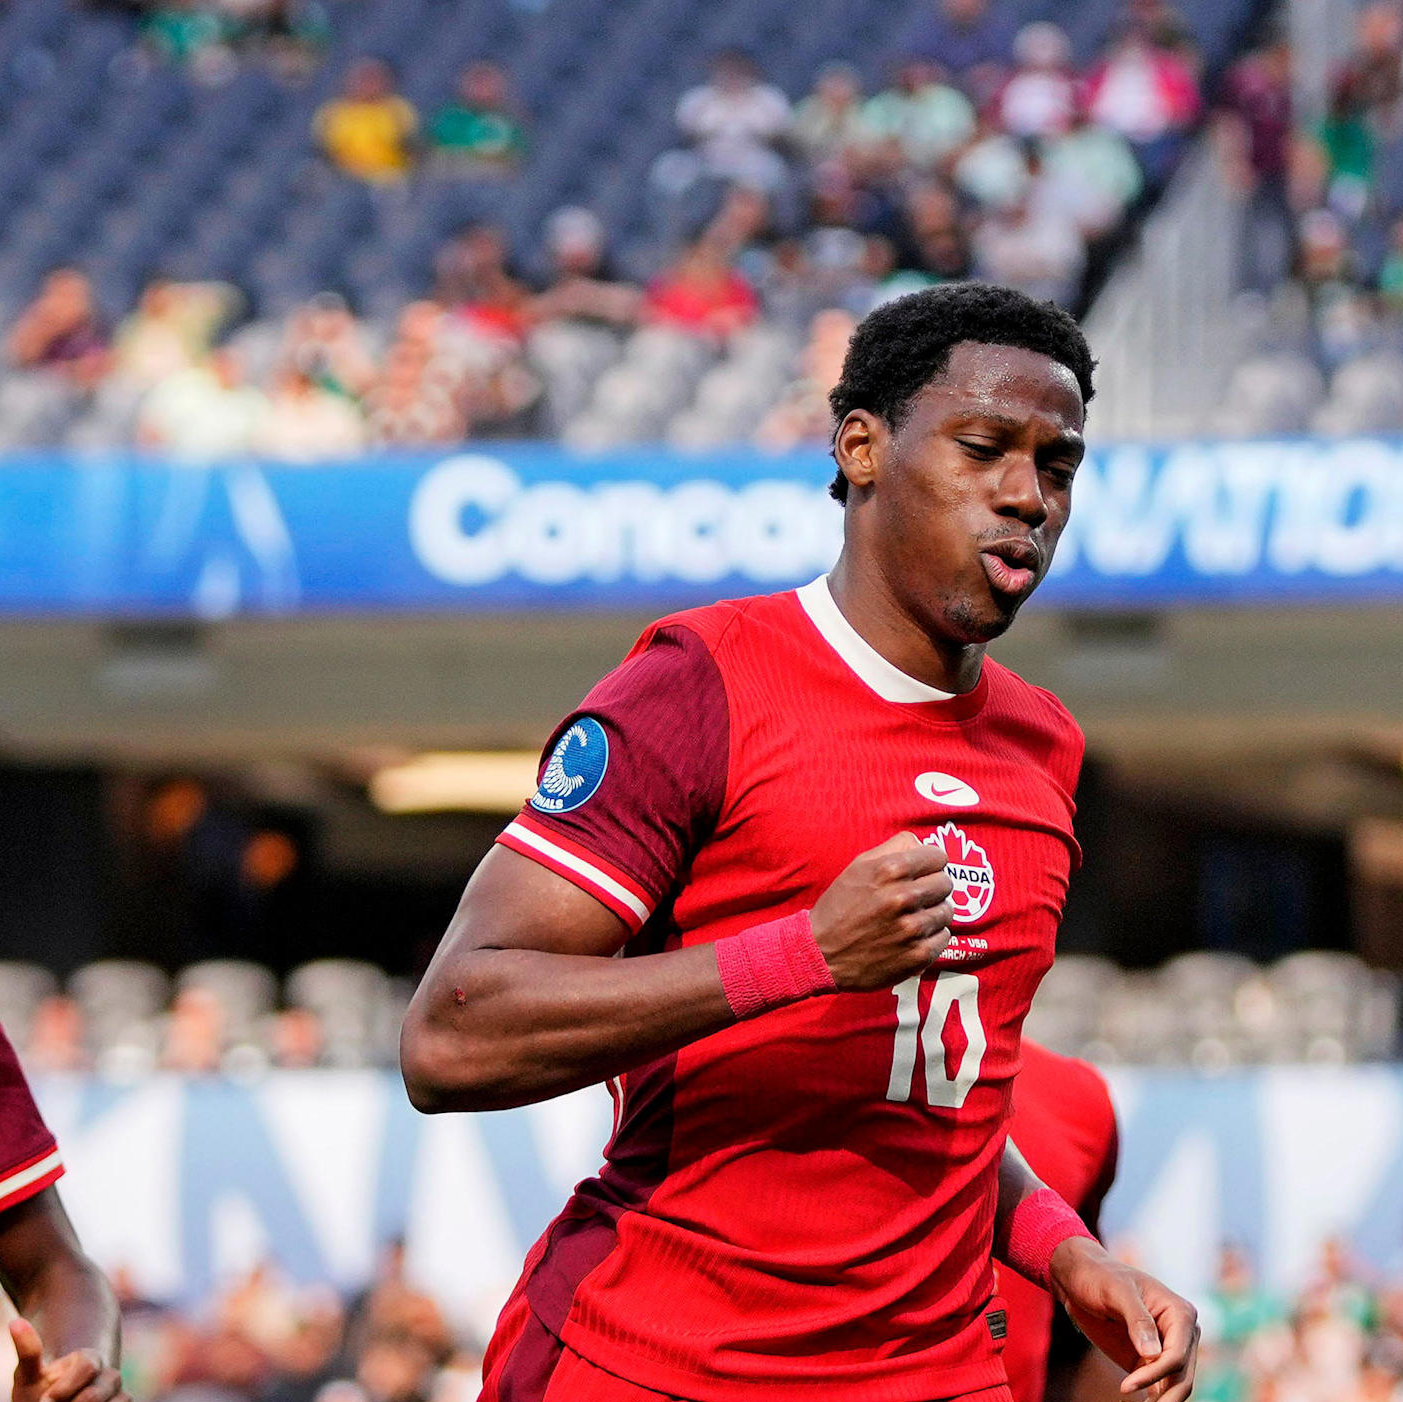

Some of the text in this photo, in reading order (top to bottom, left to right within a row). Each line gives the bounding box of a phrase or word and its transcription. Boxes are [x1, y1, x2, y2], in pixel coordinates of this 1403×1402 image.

[408, 454, 845, 586] Conca
[946, 866, 990, 885] NADA
[886, 970, 988, 1109] 10
